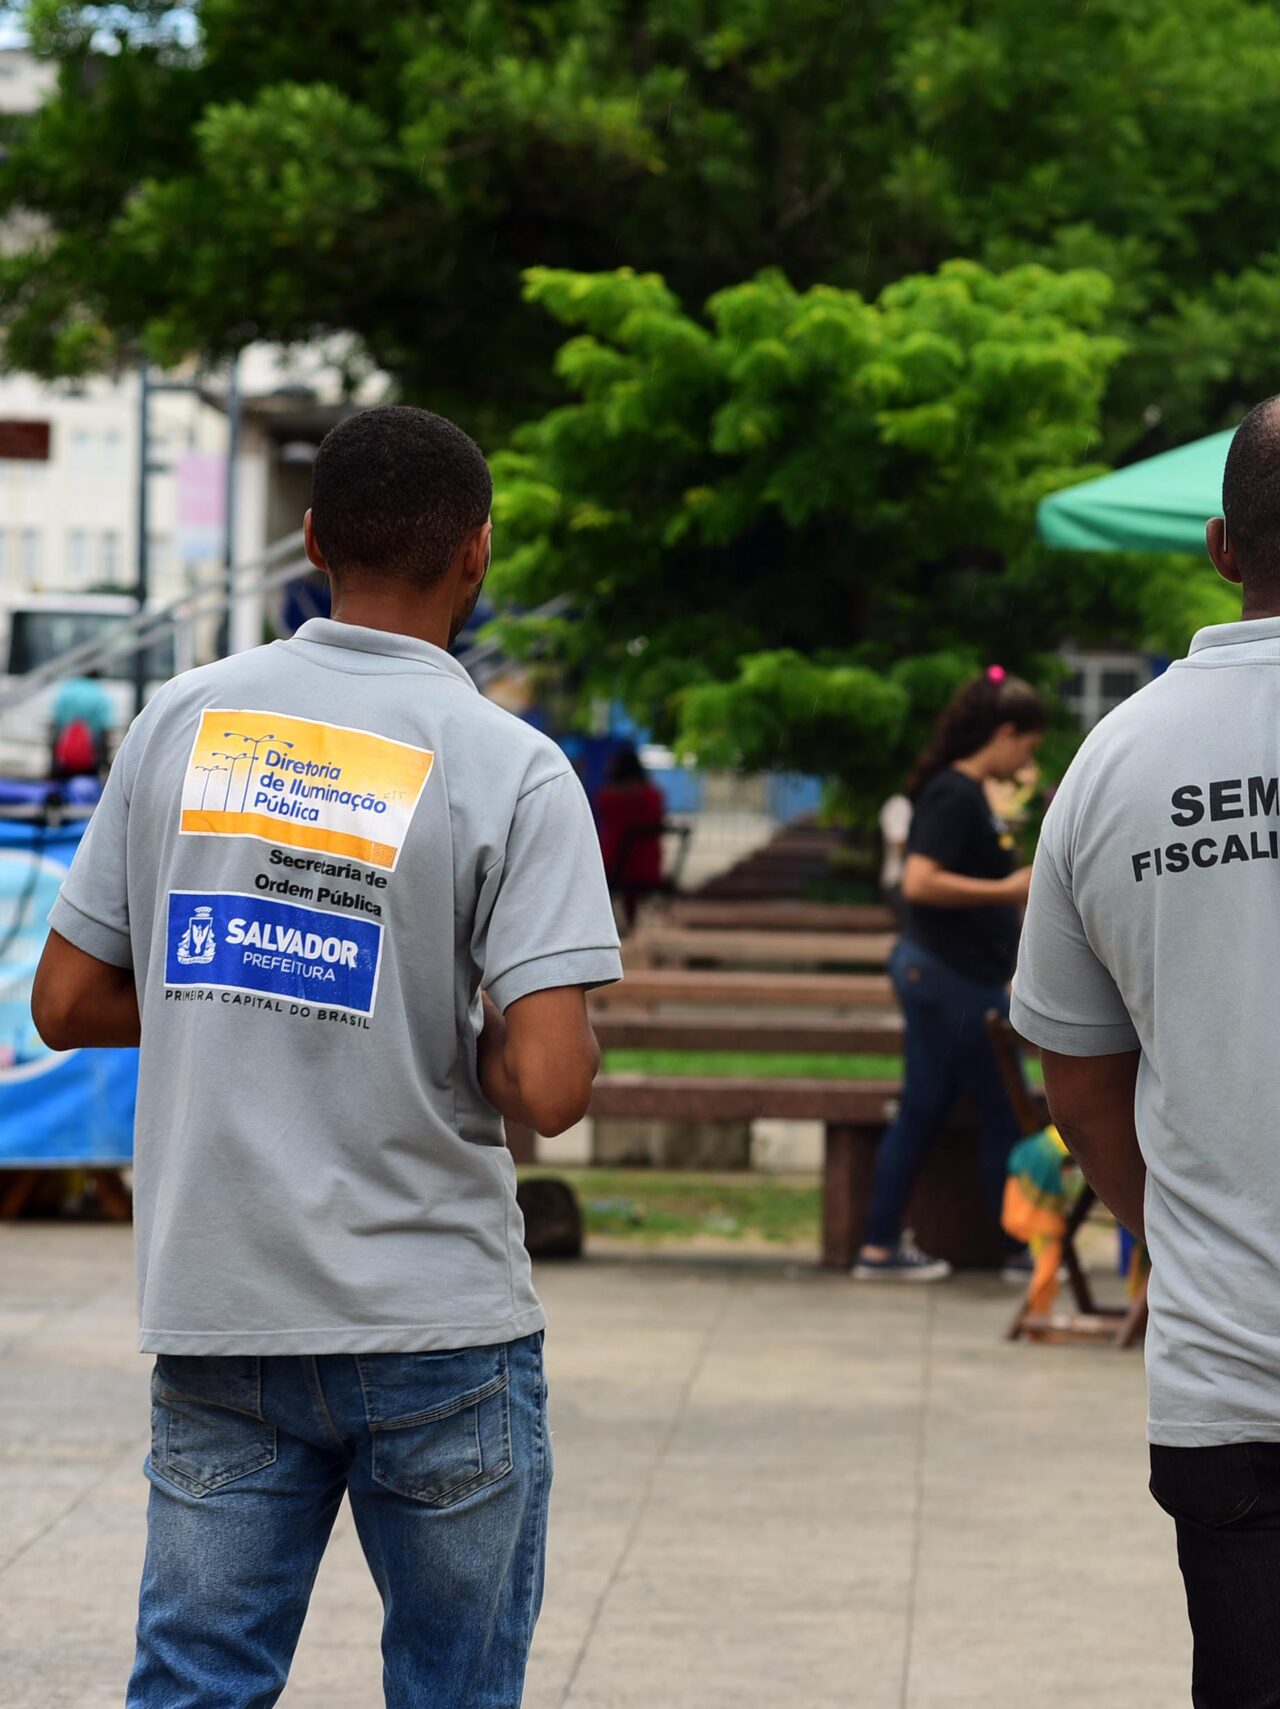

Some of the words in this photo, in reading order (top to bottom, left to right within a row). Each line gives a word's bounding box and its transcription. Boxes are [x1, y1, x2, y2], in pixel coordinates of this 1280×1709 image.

[265, 749, 342, 780] Diretoria
[254, 792, 319, 821] Pública
[260, 771, 285, 793] de
[290, 778, 387, 814] Iluminação
[269, 849, 361, 881] Secretaria
[365, 871, 388, 890] de
[255, 873, 313, 900] Ordem
[317, 886, 382, 918] Pública
[225, 917, 359, 969] SALVADOR
[243, 952, 336, 982] PREFEITURA
[165, 989, 214, 1002] PRIMEIRA
[221, 991, 283, 1013] CAPITAL
[290, 1004, 310, 1018] DO
[317, 1009, 371, 1030] BRASIL
